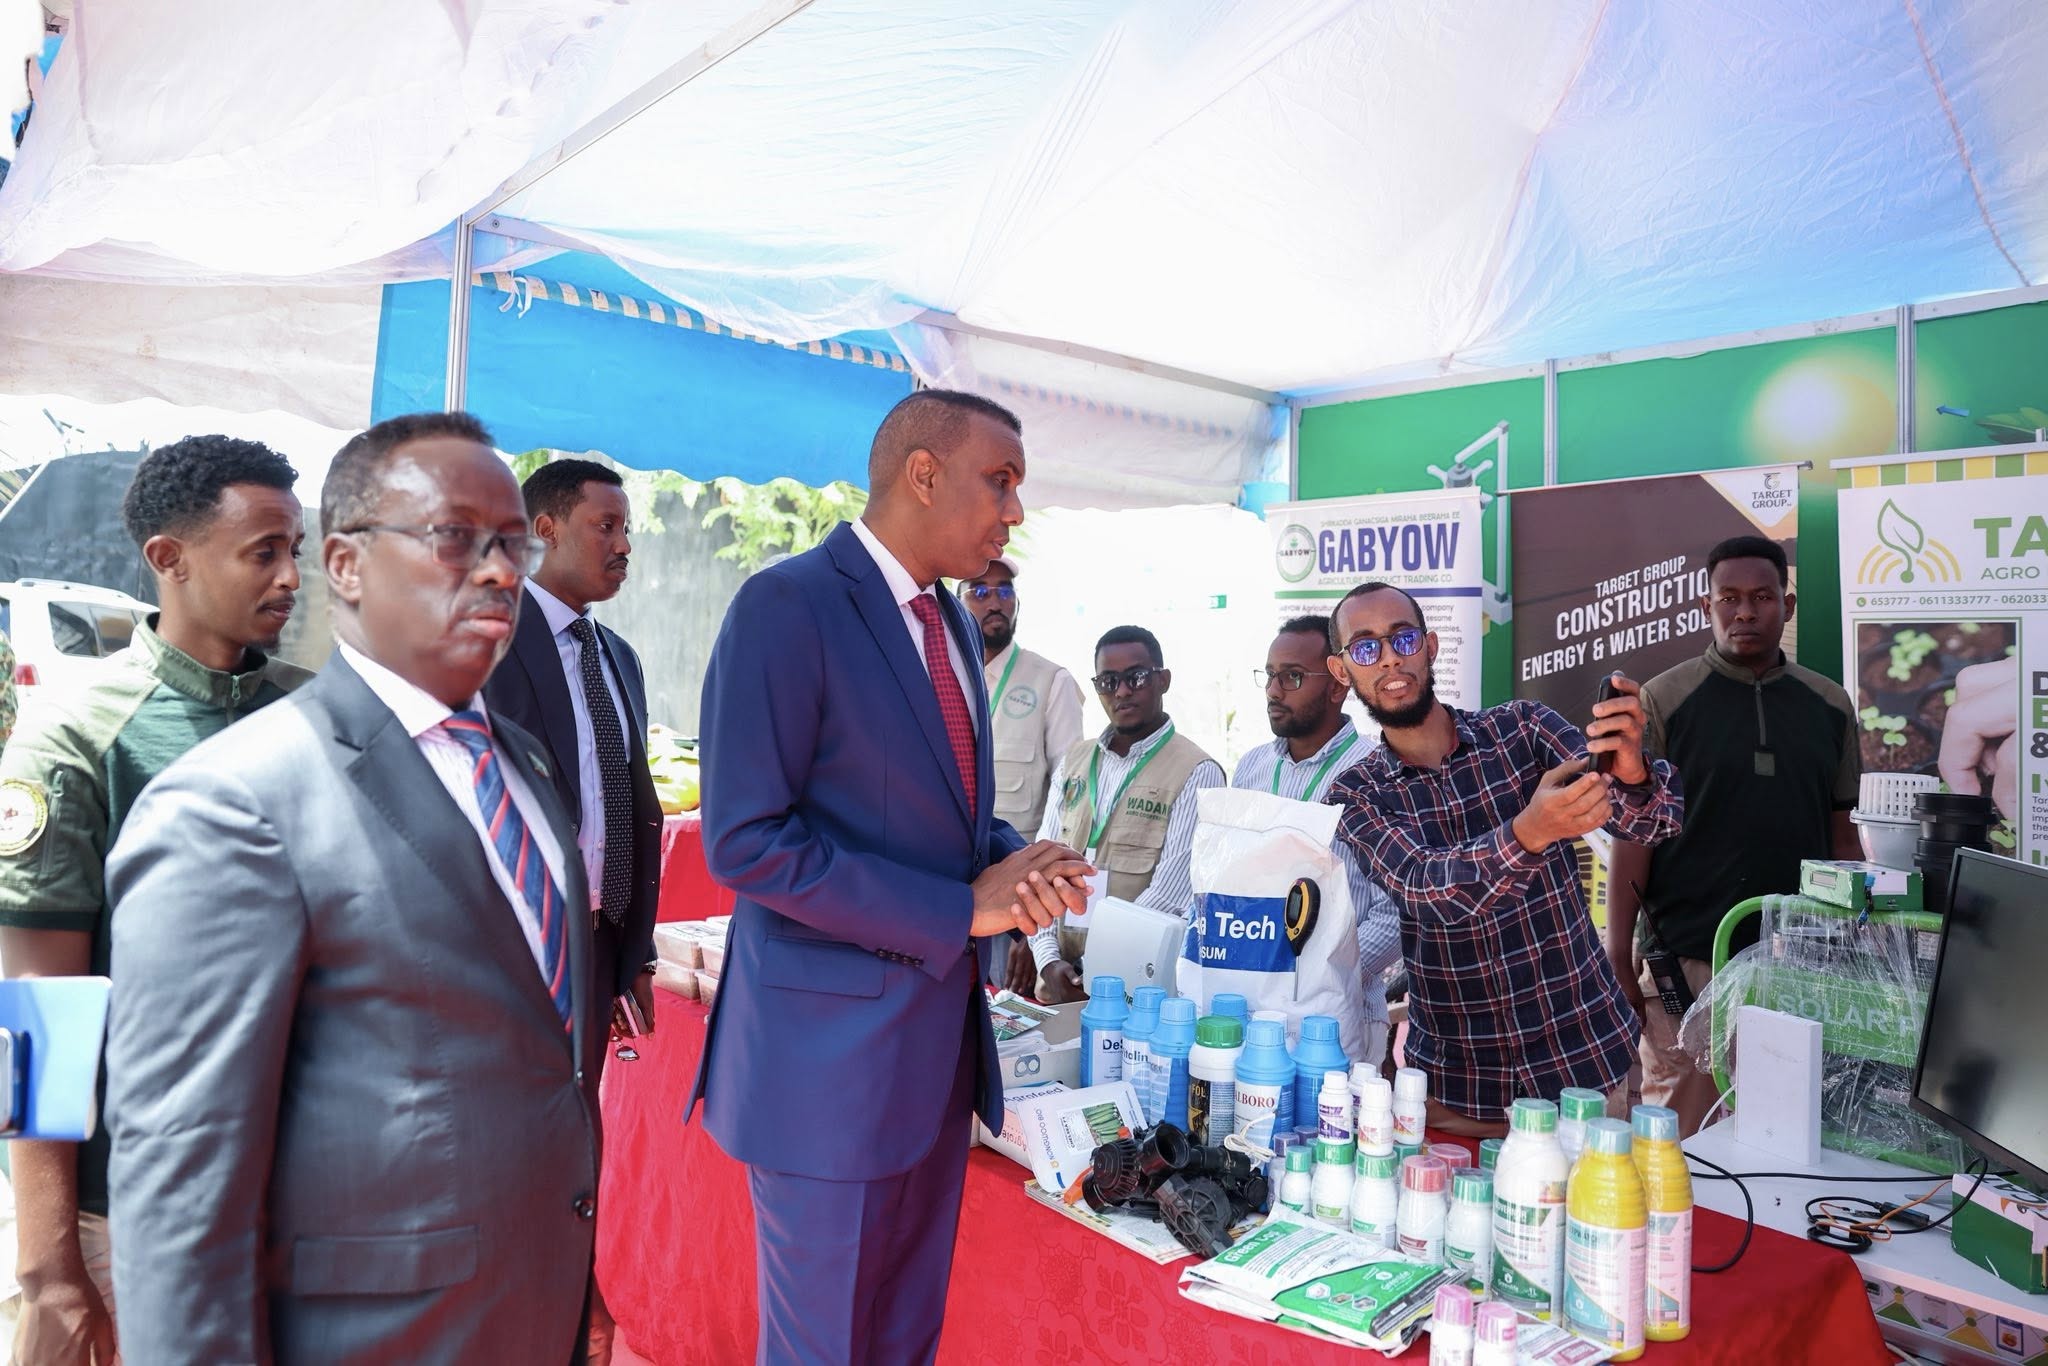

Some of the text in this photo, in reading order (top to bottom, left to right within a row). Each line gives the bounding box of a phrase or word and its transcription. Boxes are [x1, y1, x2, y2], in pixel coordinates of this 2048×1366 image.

[1752, 489, 1792, 500] TARGET
[1752, 499, 1787, 509] GROUP
[1319, 522, 1460, 574] GABYOW
[1973, 515, 2048, 559] TA
[1404, 574, 1438, 584] TRADING
[1595, 555, 1687, 599] TARGET GROUP
[1980, 566, 2041, 581] AGRO
[1556, 567, 1711, 641] CONSTRUCTIO
[1870, 596, 1910, 606] 653777
[1919, 594, 1991, 605] 0611333777
[2001, 593, 2048, 604] 062033
[1440, 647, 1458, 655] good
[1521, 608, 1712, 682] ENERGY & WATER SOL
[1214, 911, 1276, 940] Tech
[1776, 992, 1890, 1036] SOLAR
